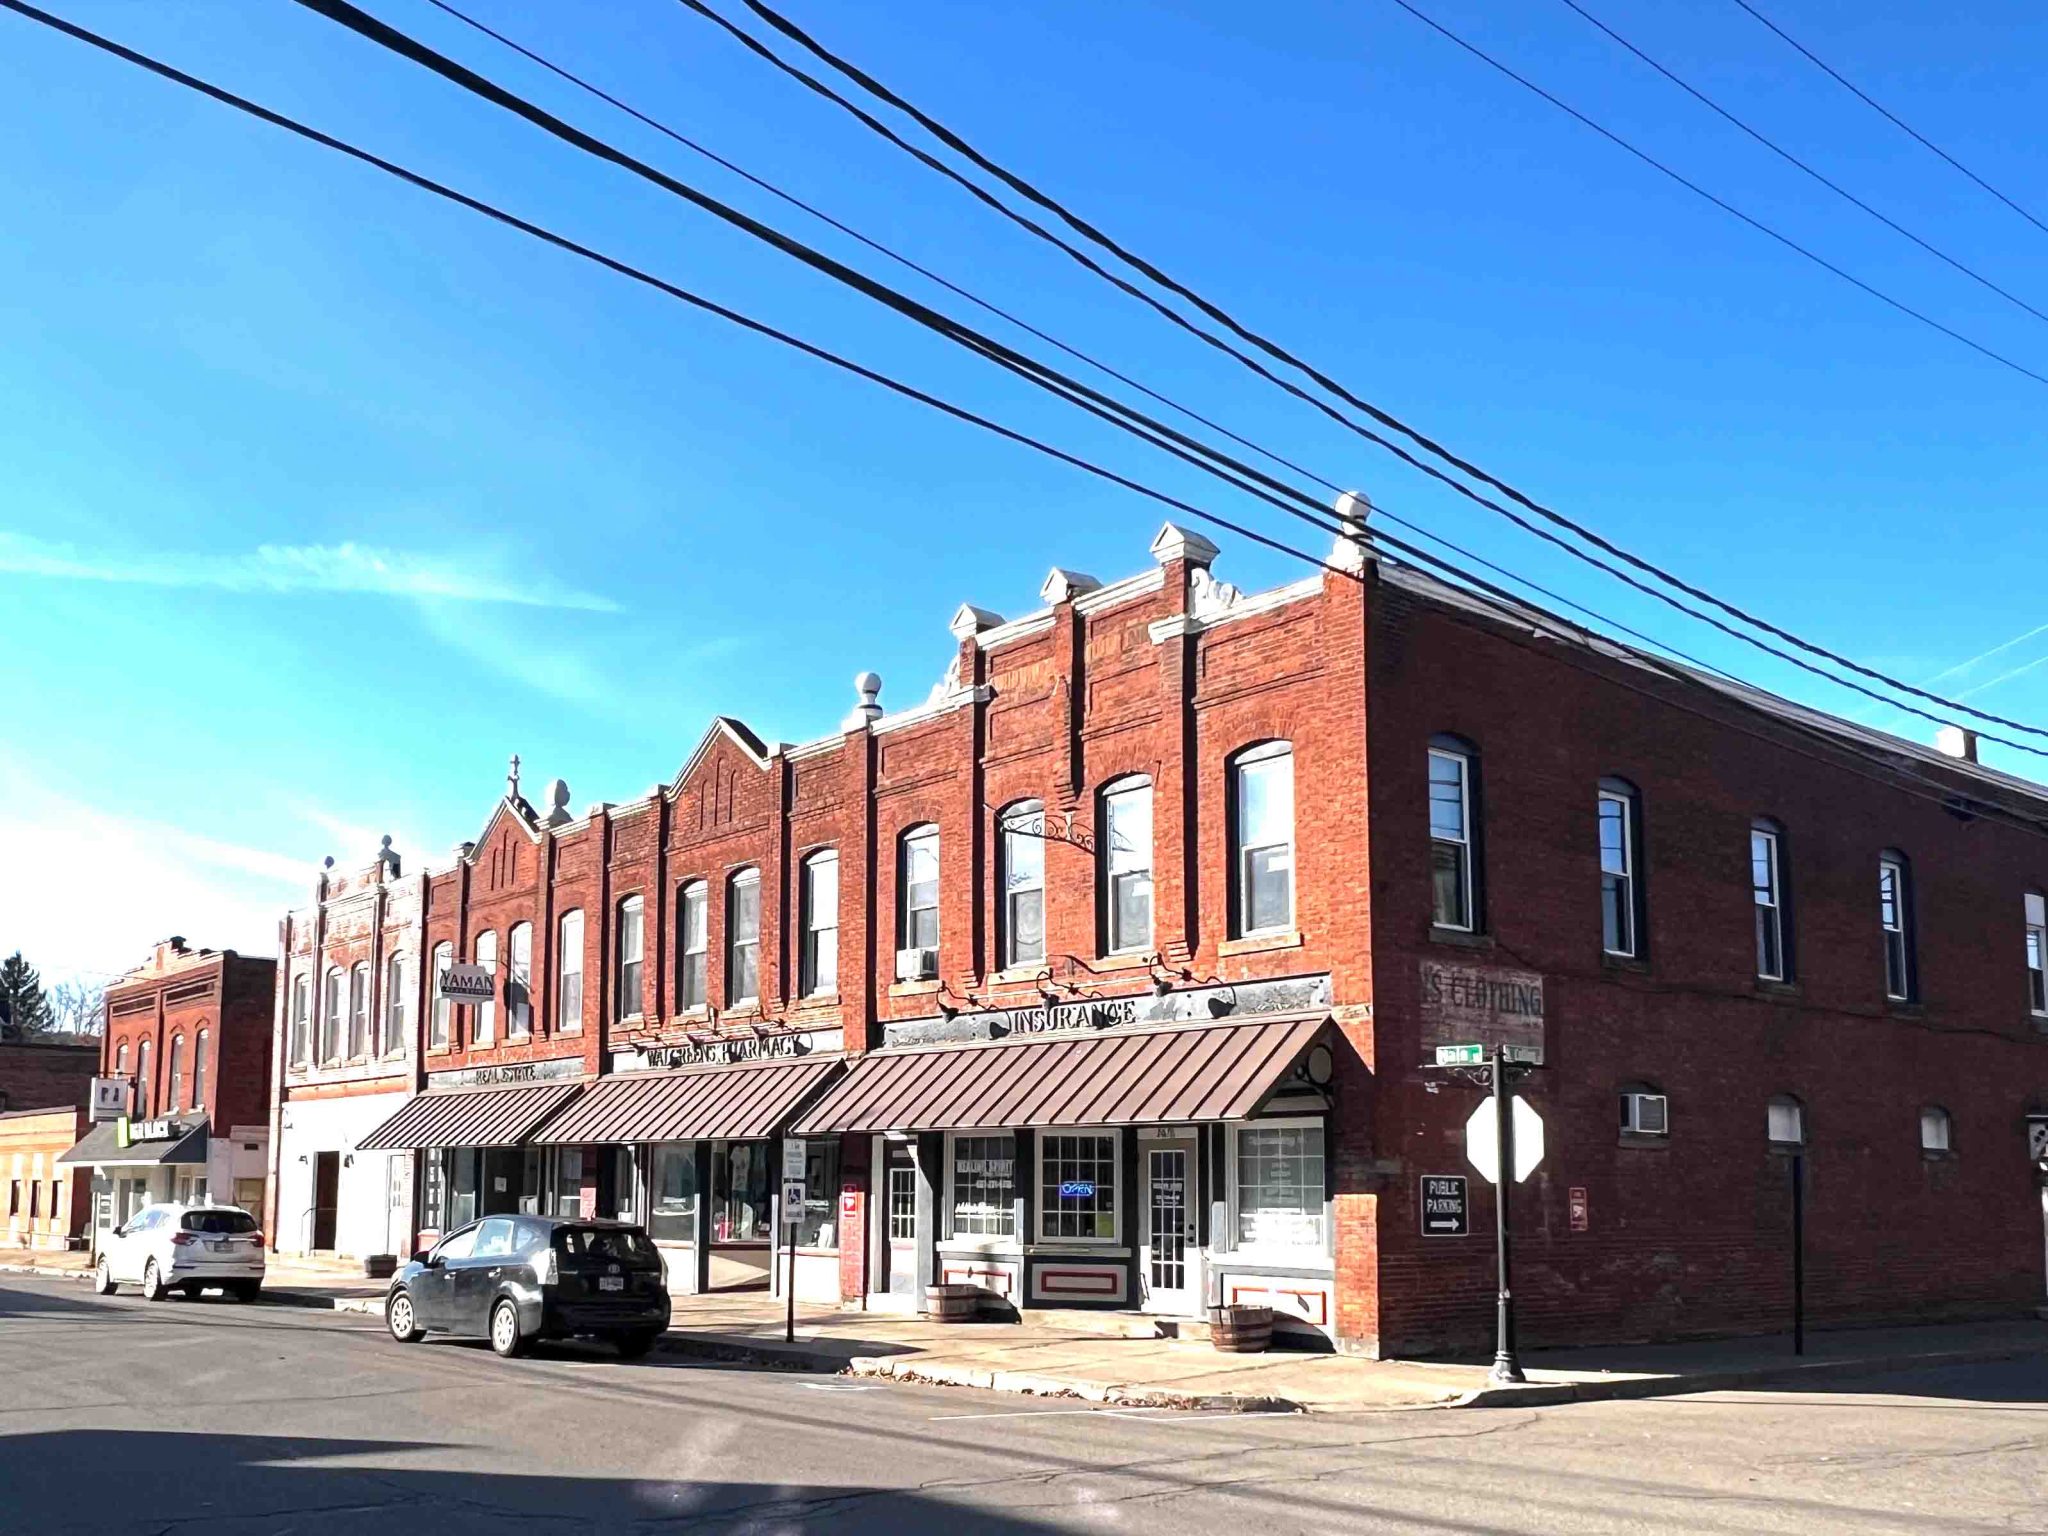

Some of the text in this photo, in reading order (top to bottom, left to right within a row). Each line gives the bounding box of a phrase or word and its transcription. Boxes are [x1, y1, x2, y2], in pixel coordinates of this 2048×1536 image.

[440, 969, 495, 990] YAMAN
[1453, 972, 1543, 1016] CLOTHING
[1013, 1000, 1137, 1035] INSURANCE
[721, 1035, 801, 1065] PHARMACY
[476, 1068, 499, 1085] REAL
[1061, 1182, 1094, 1195] OPEN
[1429, 1181, 1459, 1195] PUBLIC
[1427, 1199, 1462, 1213] PARKING
